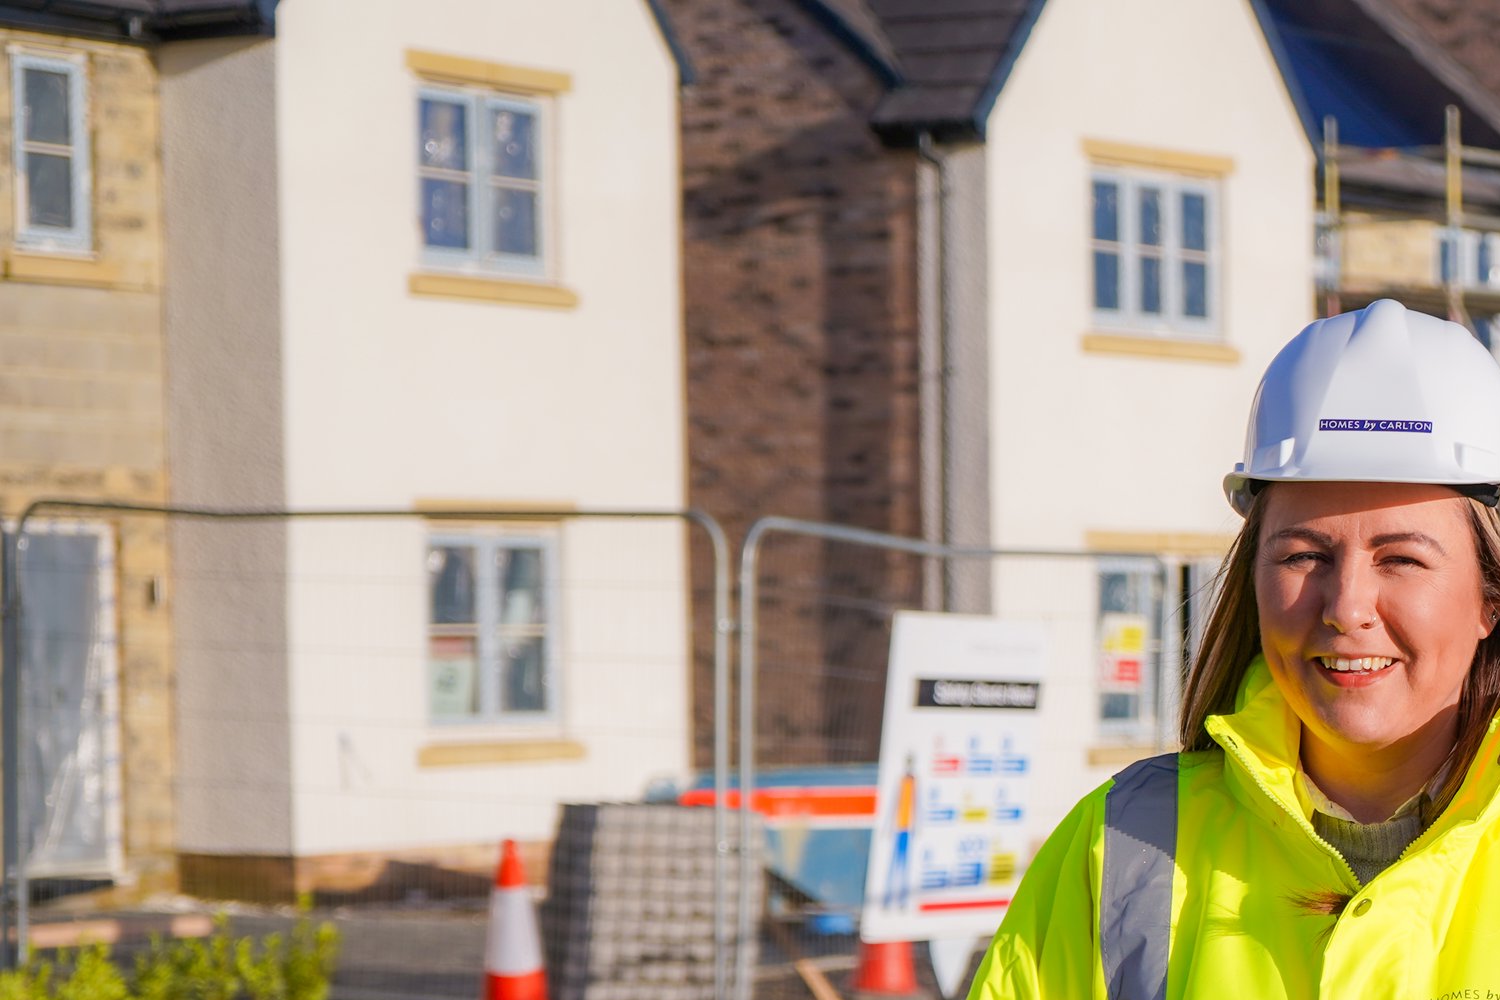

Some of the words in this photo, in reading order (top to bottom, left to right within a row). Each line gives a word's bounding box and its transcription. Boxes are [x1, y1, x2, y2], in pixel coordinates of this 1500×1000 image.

[1320, 420, 1360, 429] HOMES
[1363, 420, 1376, 431] by
[1379, 421, 1432, 431] CARLTON
